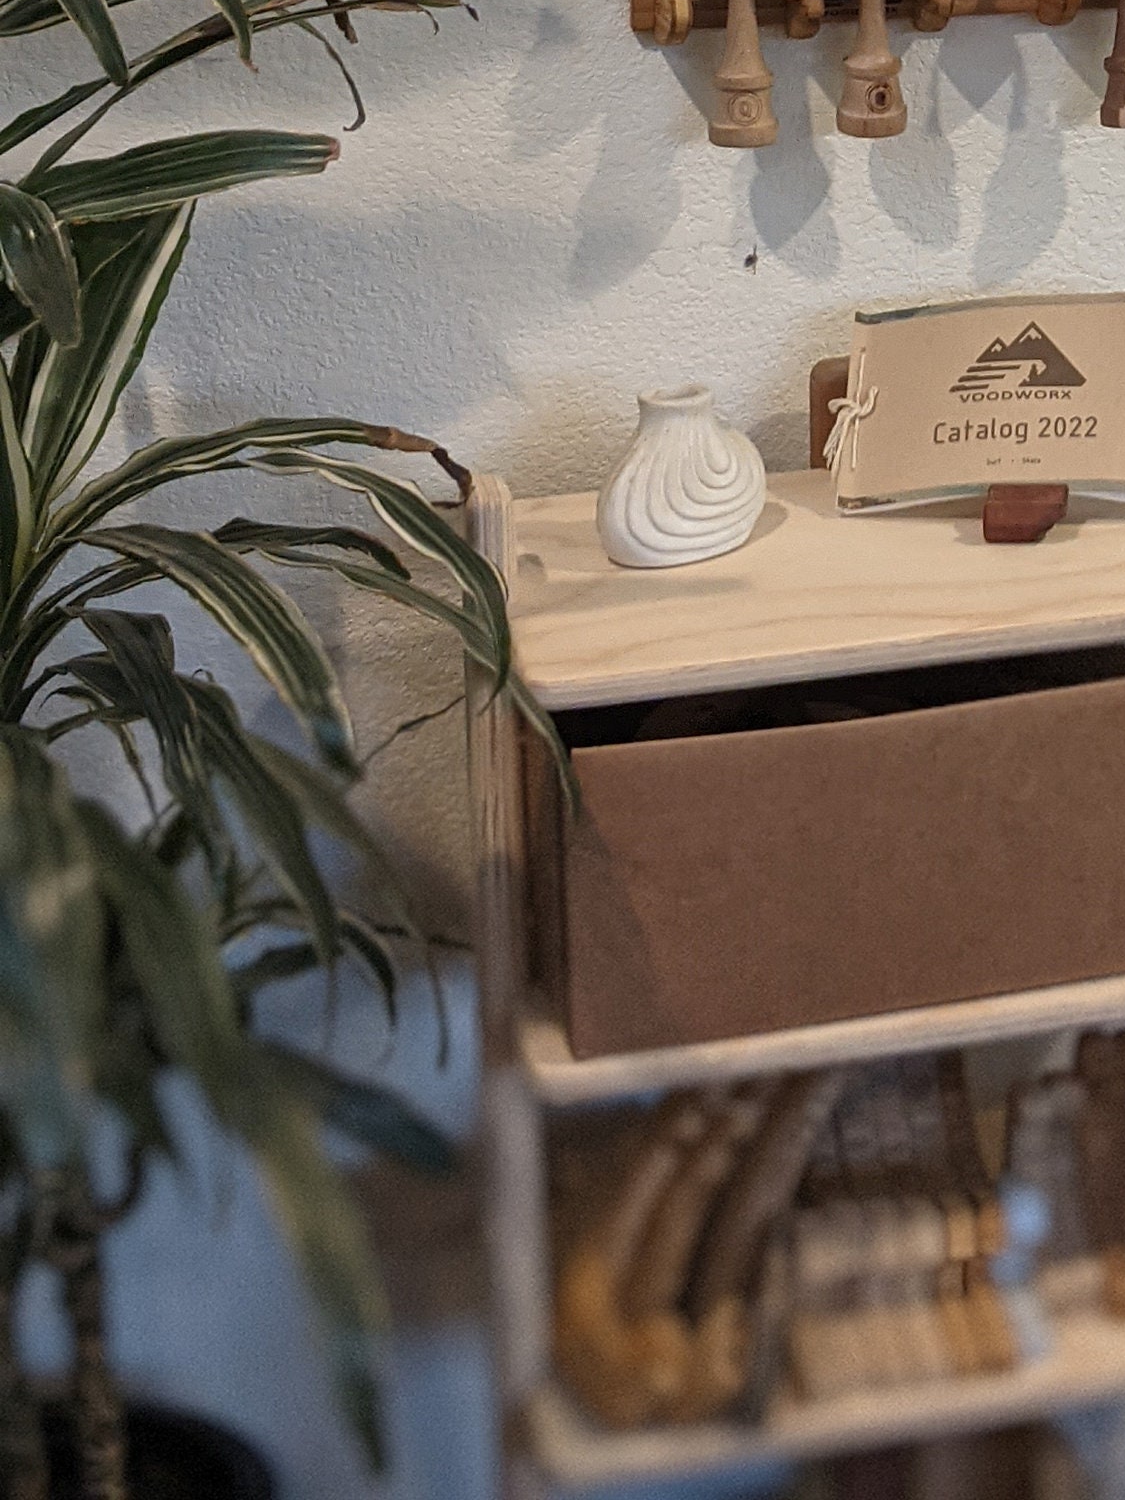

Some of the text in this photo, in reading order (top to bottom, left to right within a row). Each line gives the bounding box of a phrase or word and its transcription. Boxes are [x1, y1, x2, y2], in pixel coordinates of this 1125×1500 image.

[959, 389, 1073, 404] VOODWORX
[932, 416, 1099, 445] Catalog 2022
